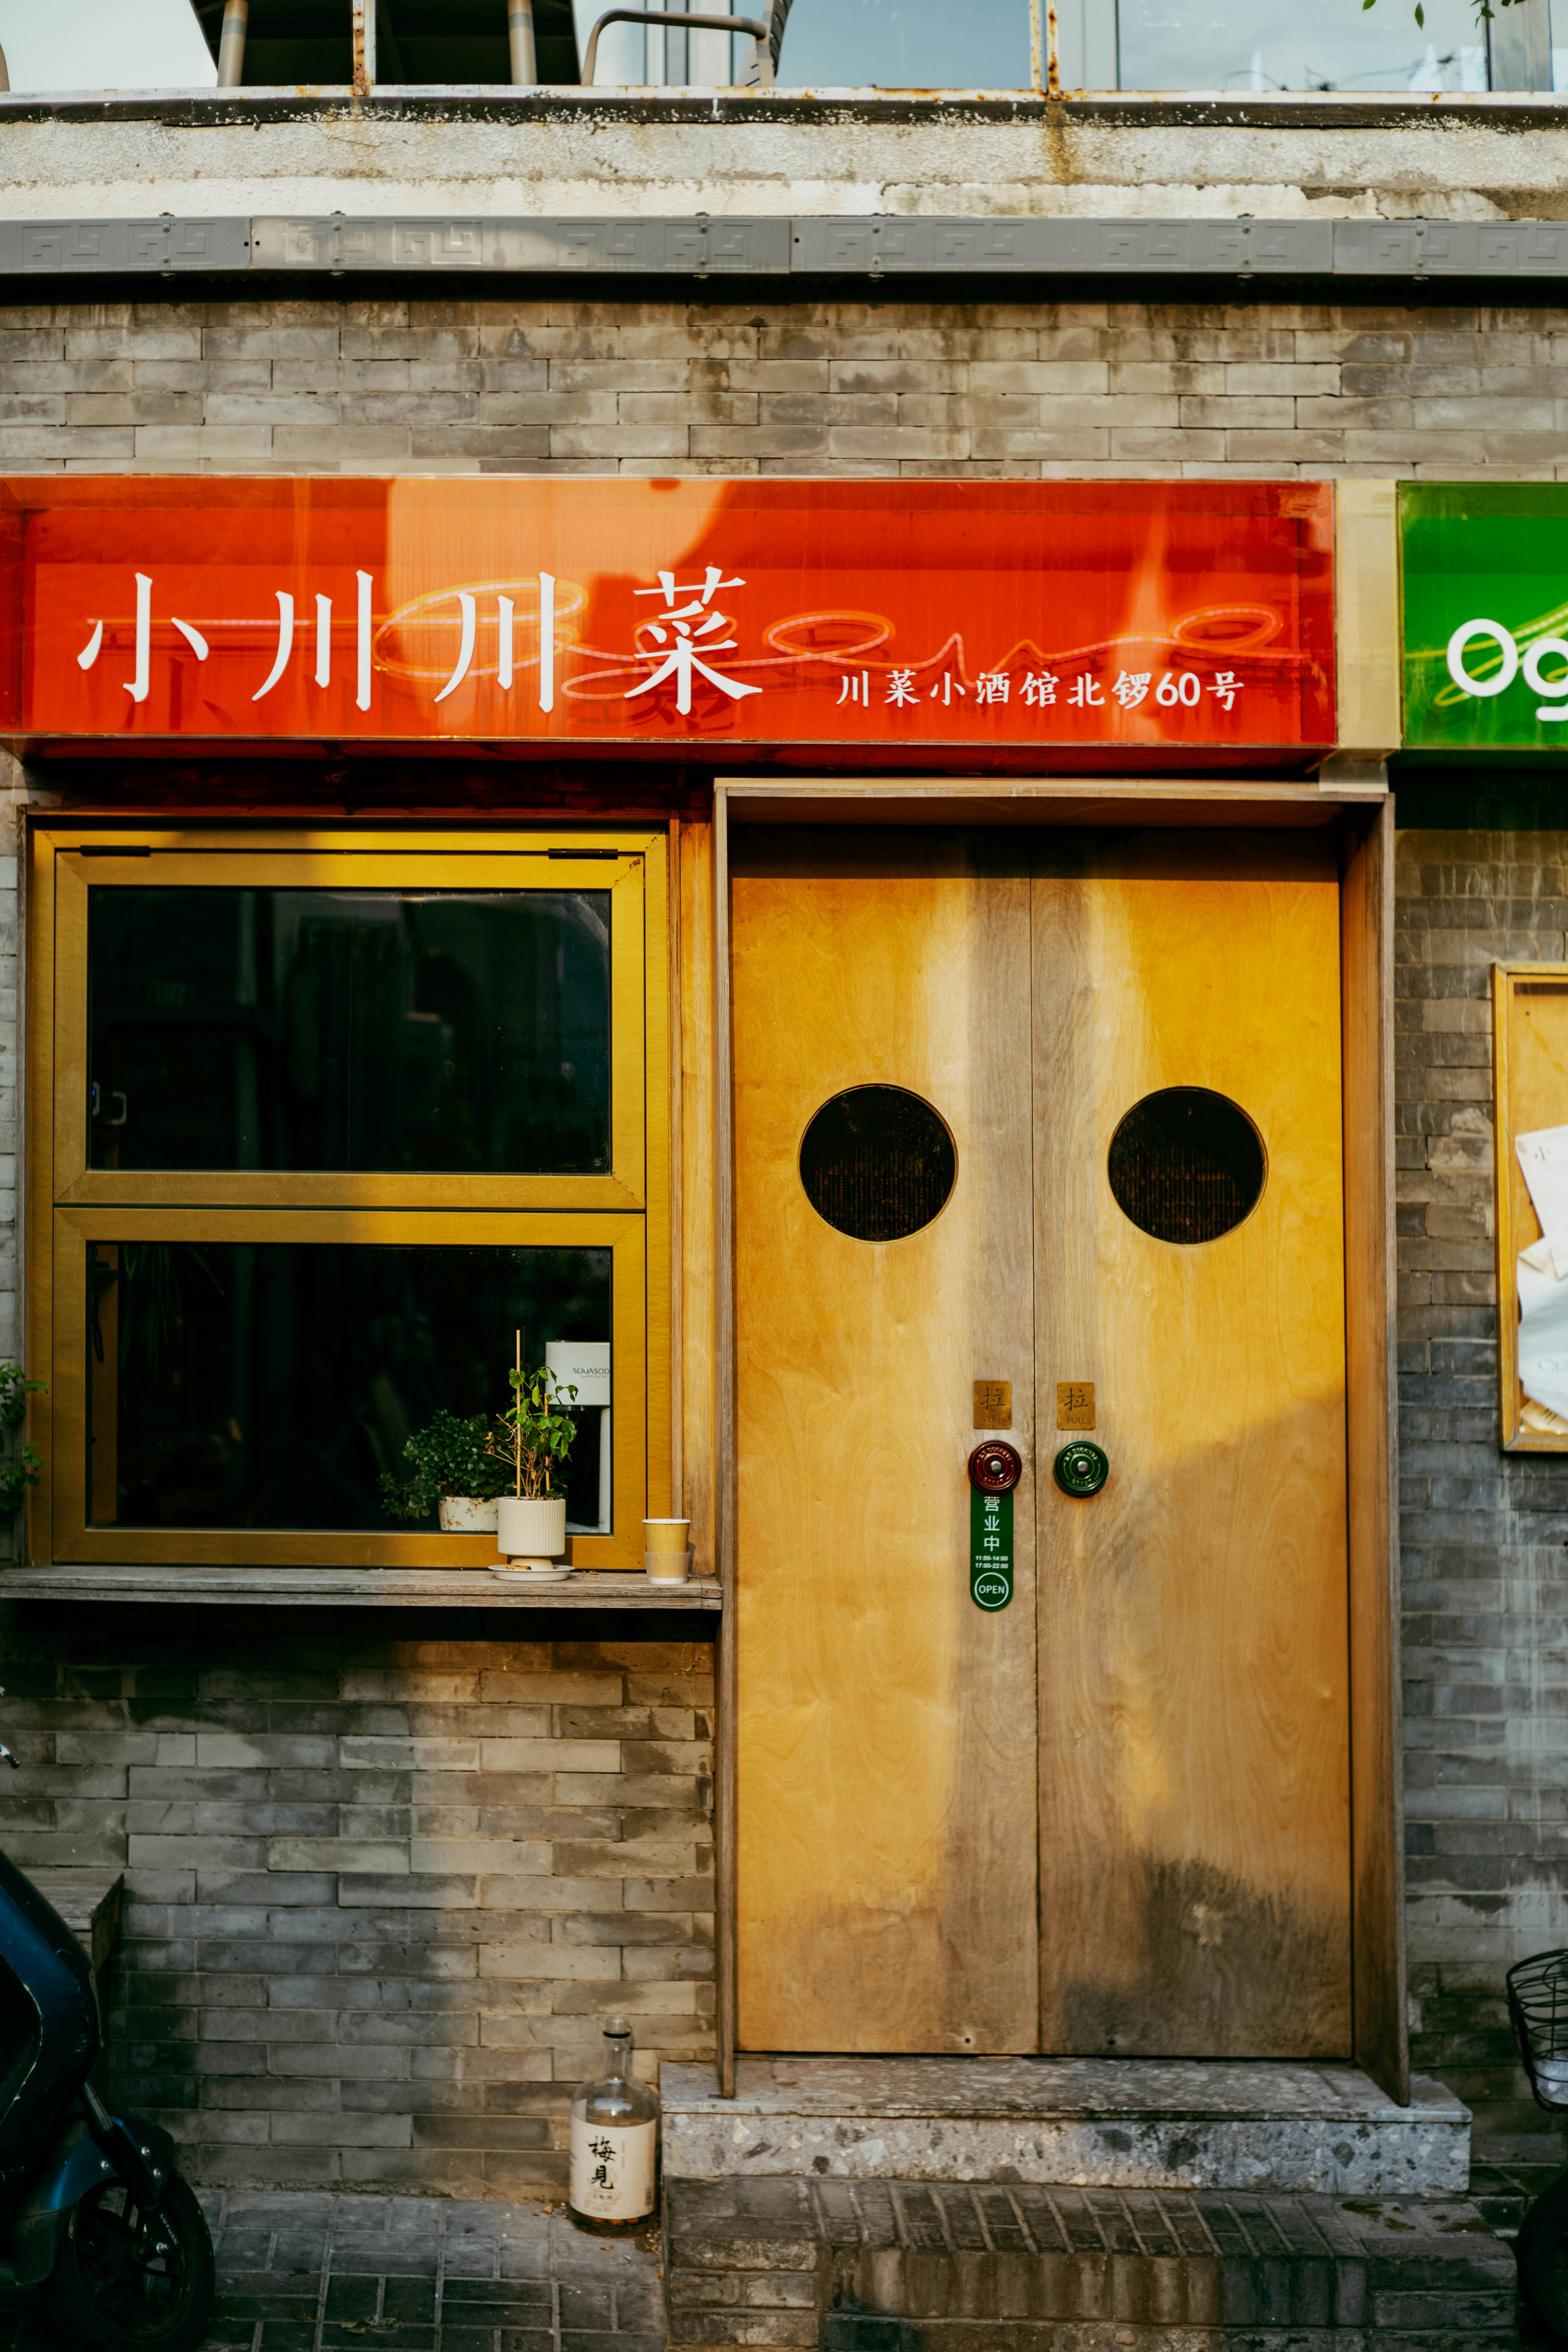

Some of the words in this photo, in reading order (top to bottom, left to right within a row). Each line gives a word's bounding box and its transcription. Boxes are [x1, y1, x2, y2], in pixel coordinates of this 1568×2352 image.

[76, 564, 763, 716] 小川川菜
[836, 668, 1244, 711] 川菜小酒馆北锣60号
[980, 1387, 1005, 1410] 拉
[1064, 1388, 1089, 1411] 拉
[984, 1496, 1000, 1551] 营业中
[979, 1585, 1005, 1594] OPEN
[160, 2213, 178, 2245] LUYUAN
